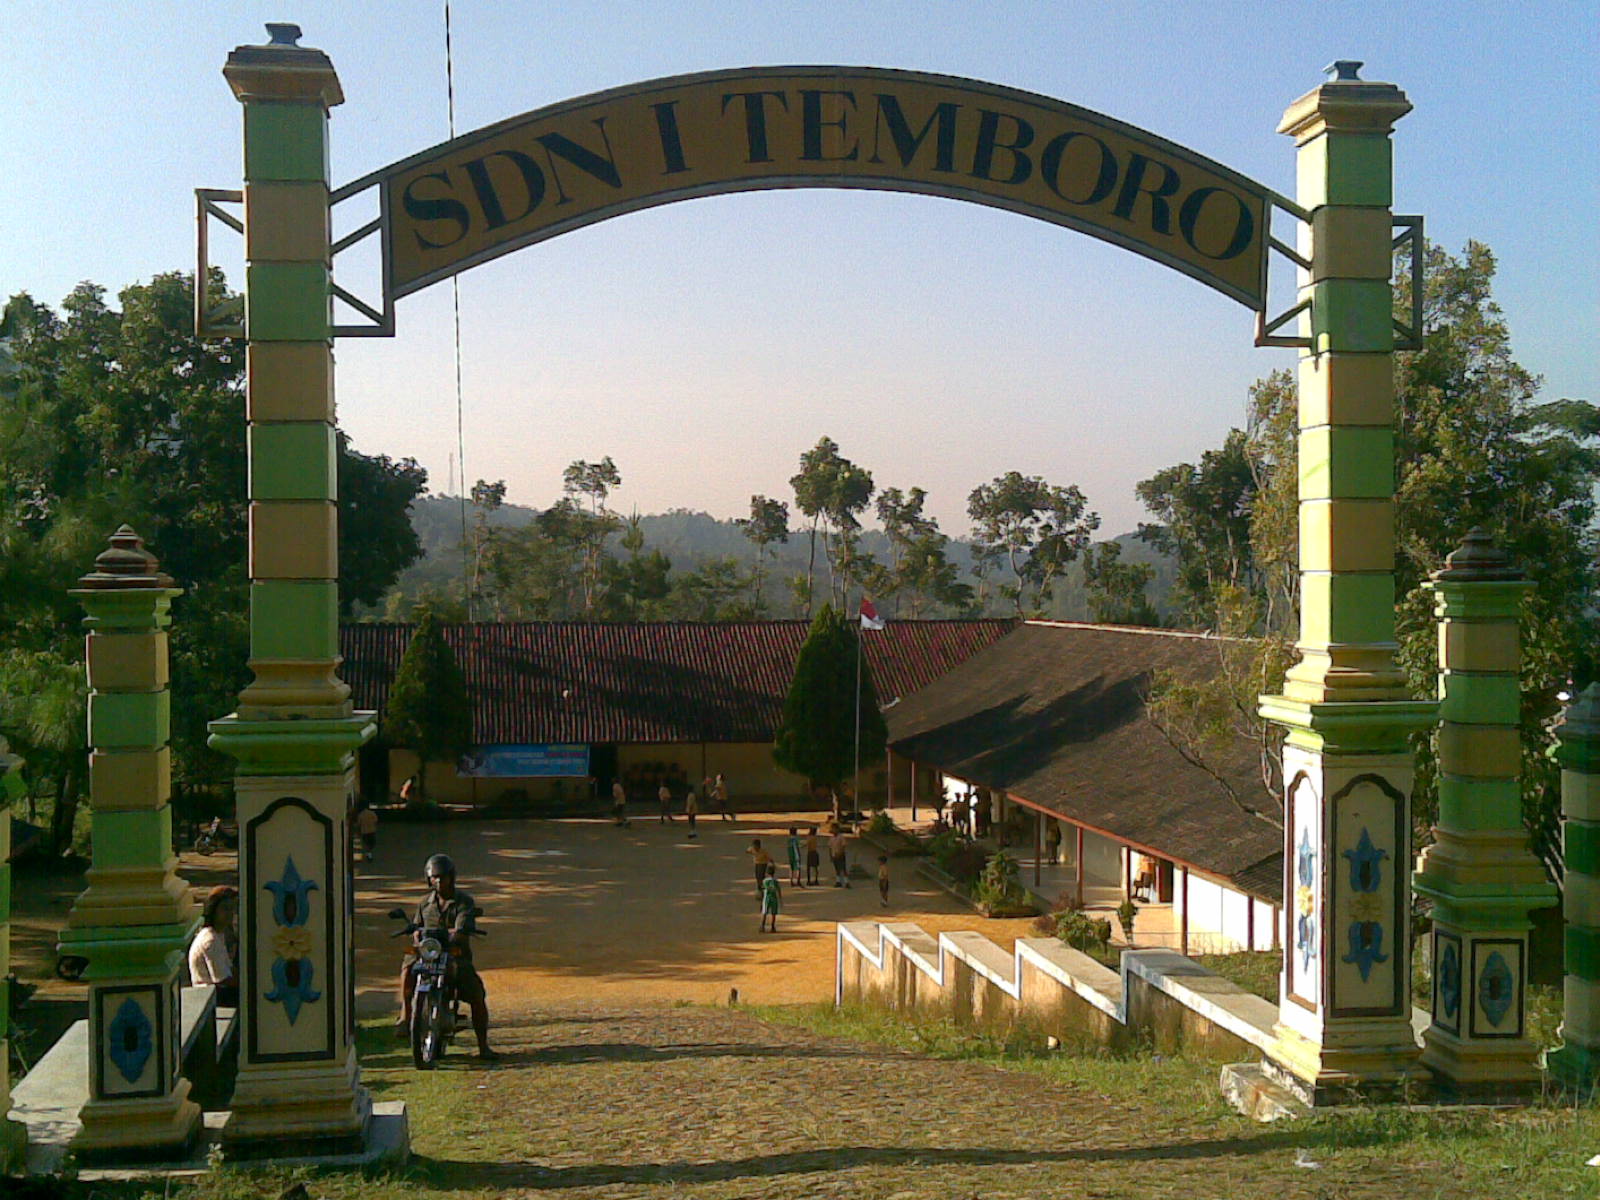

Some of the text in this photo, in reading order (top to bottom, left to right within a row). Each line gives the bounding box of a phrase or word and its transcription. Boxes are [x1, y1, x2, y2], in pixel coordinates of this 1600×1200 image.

[403, 89, 1254, 260] SDN I TEMBORO
